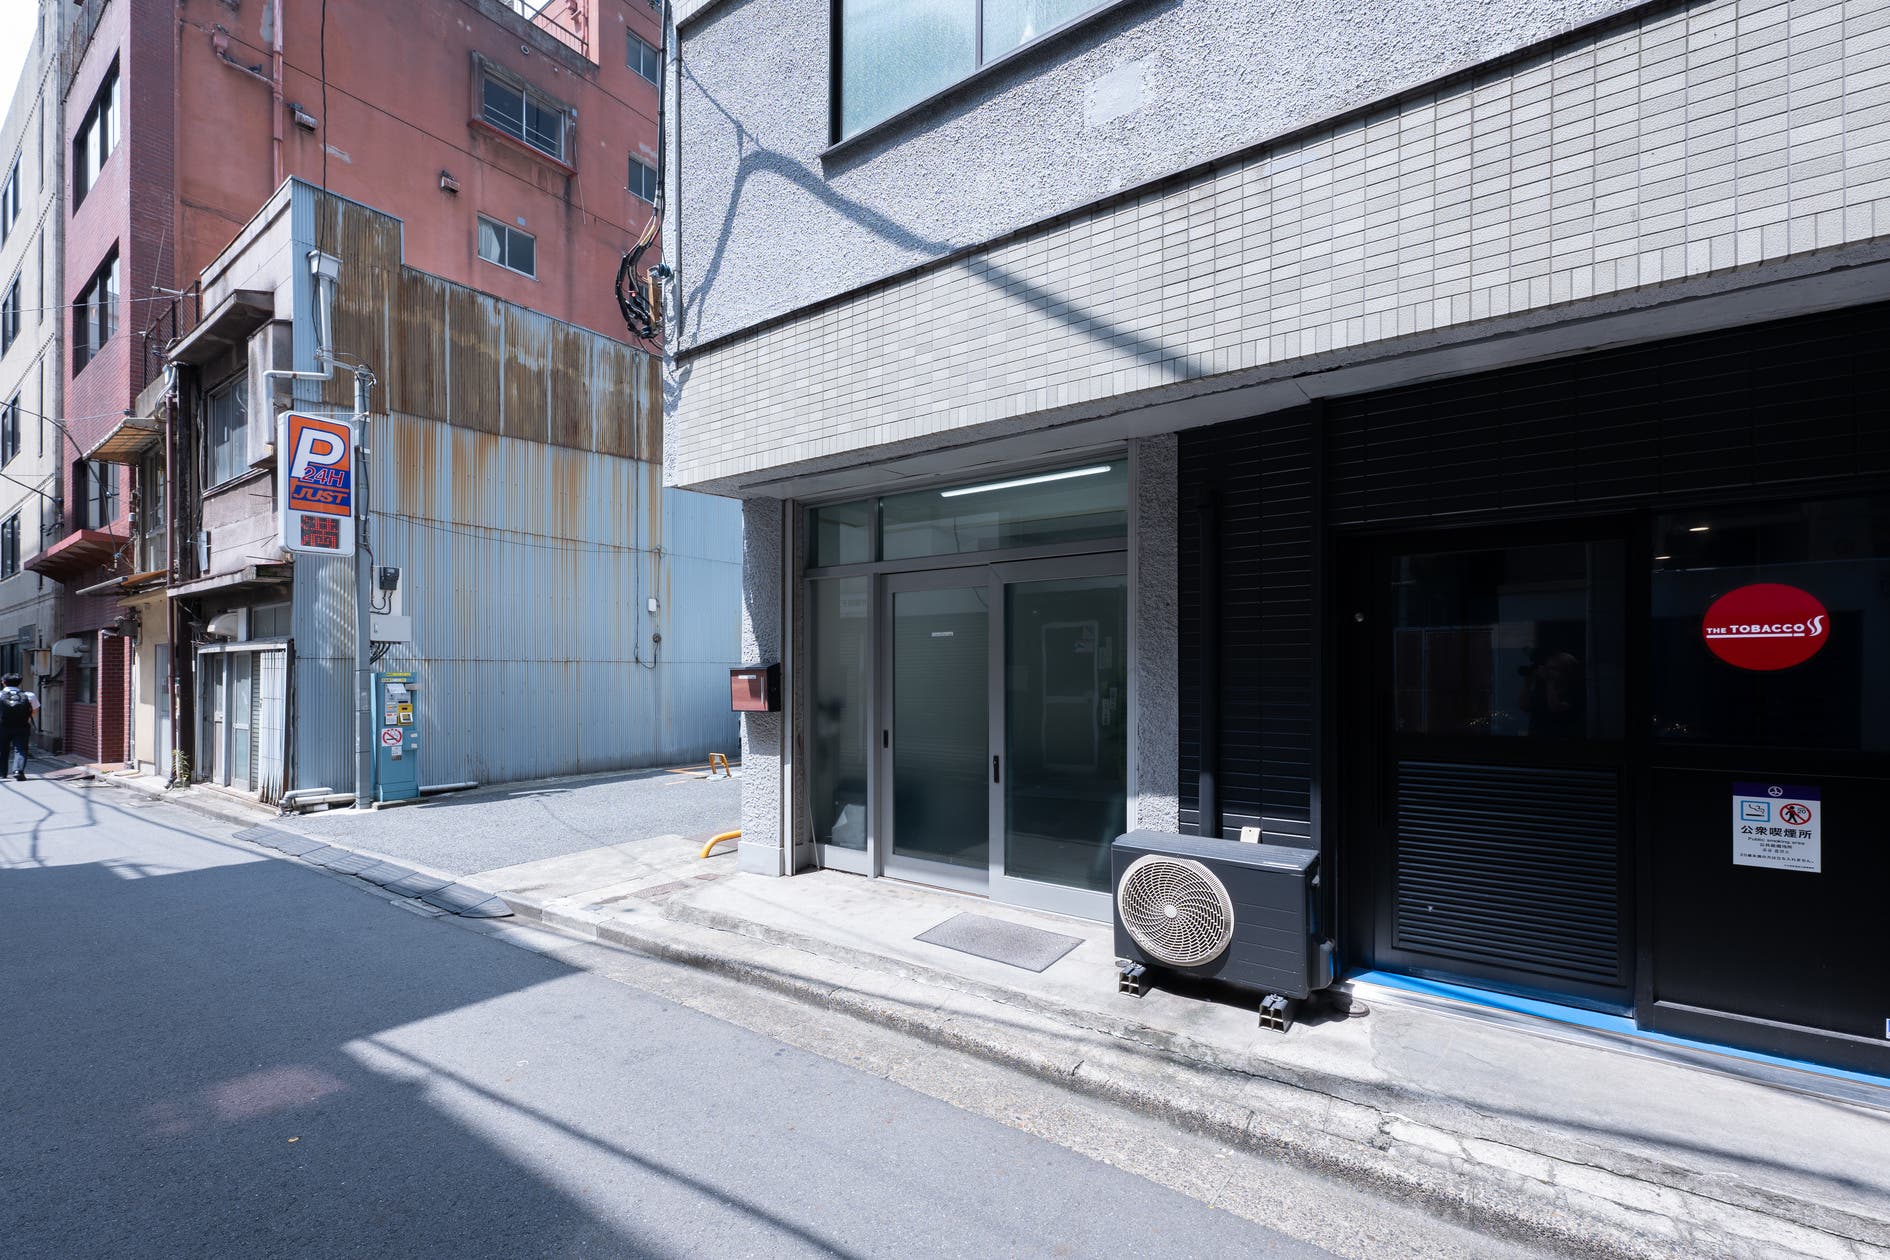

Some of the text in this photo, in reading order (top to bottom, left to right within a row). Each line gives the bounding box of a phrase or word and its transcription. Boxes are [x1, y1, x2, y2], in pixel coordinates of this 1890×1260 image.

[291, 426, 346, 478] P
[301, 466, 344, 487] 24H
[292, 487, 348, 504] JUST
[1729, 624, 1805, 633] TOBACCO
[1741, 825, 1812, 839] 公衆喫煙所
